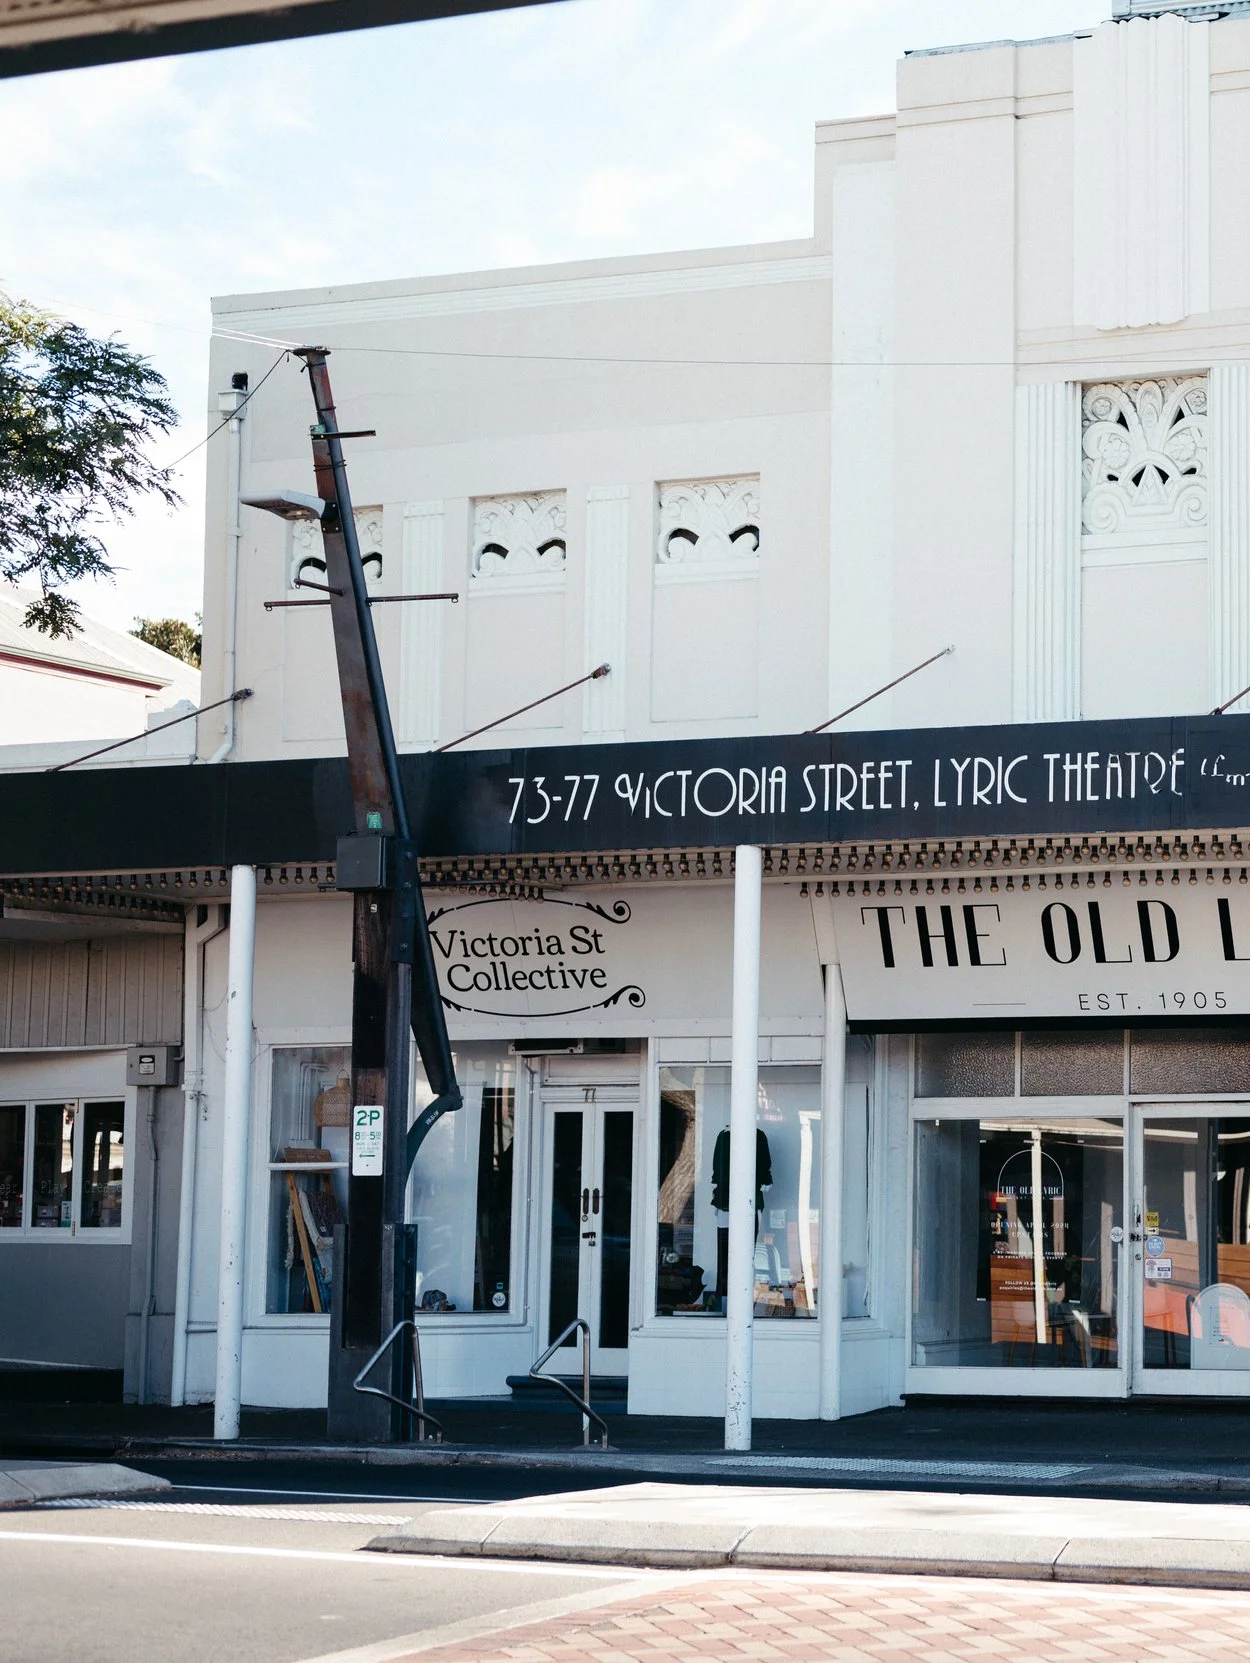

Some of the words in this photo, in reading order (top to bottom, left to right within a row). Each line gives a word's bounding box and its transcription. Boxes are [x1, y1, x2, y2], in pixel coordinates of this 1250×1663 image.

[508, 774, 600, 824] 73-77
[614, 765, 786, 819] VICTORIA
[800, 759, 921, 813] STREET,
[935, 754, 1028, 808] LYRIC
[1043, 748, 1185, 803] THEATRE
[428, 927, 565, 959] Victoria
[569, 925, 606, 955] St
[861, 904, 1007, 968] THE
[1041, 899, 1180, 964] OLD
[446, 961, 608, 992] Collective
[1078, 993, 1143, 1011] EST.
[1158, 991, 1229, 1010] 1905
[582, 1088, 597, 1103] 77
[356, 1109, 381, 1126] 2P
